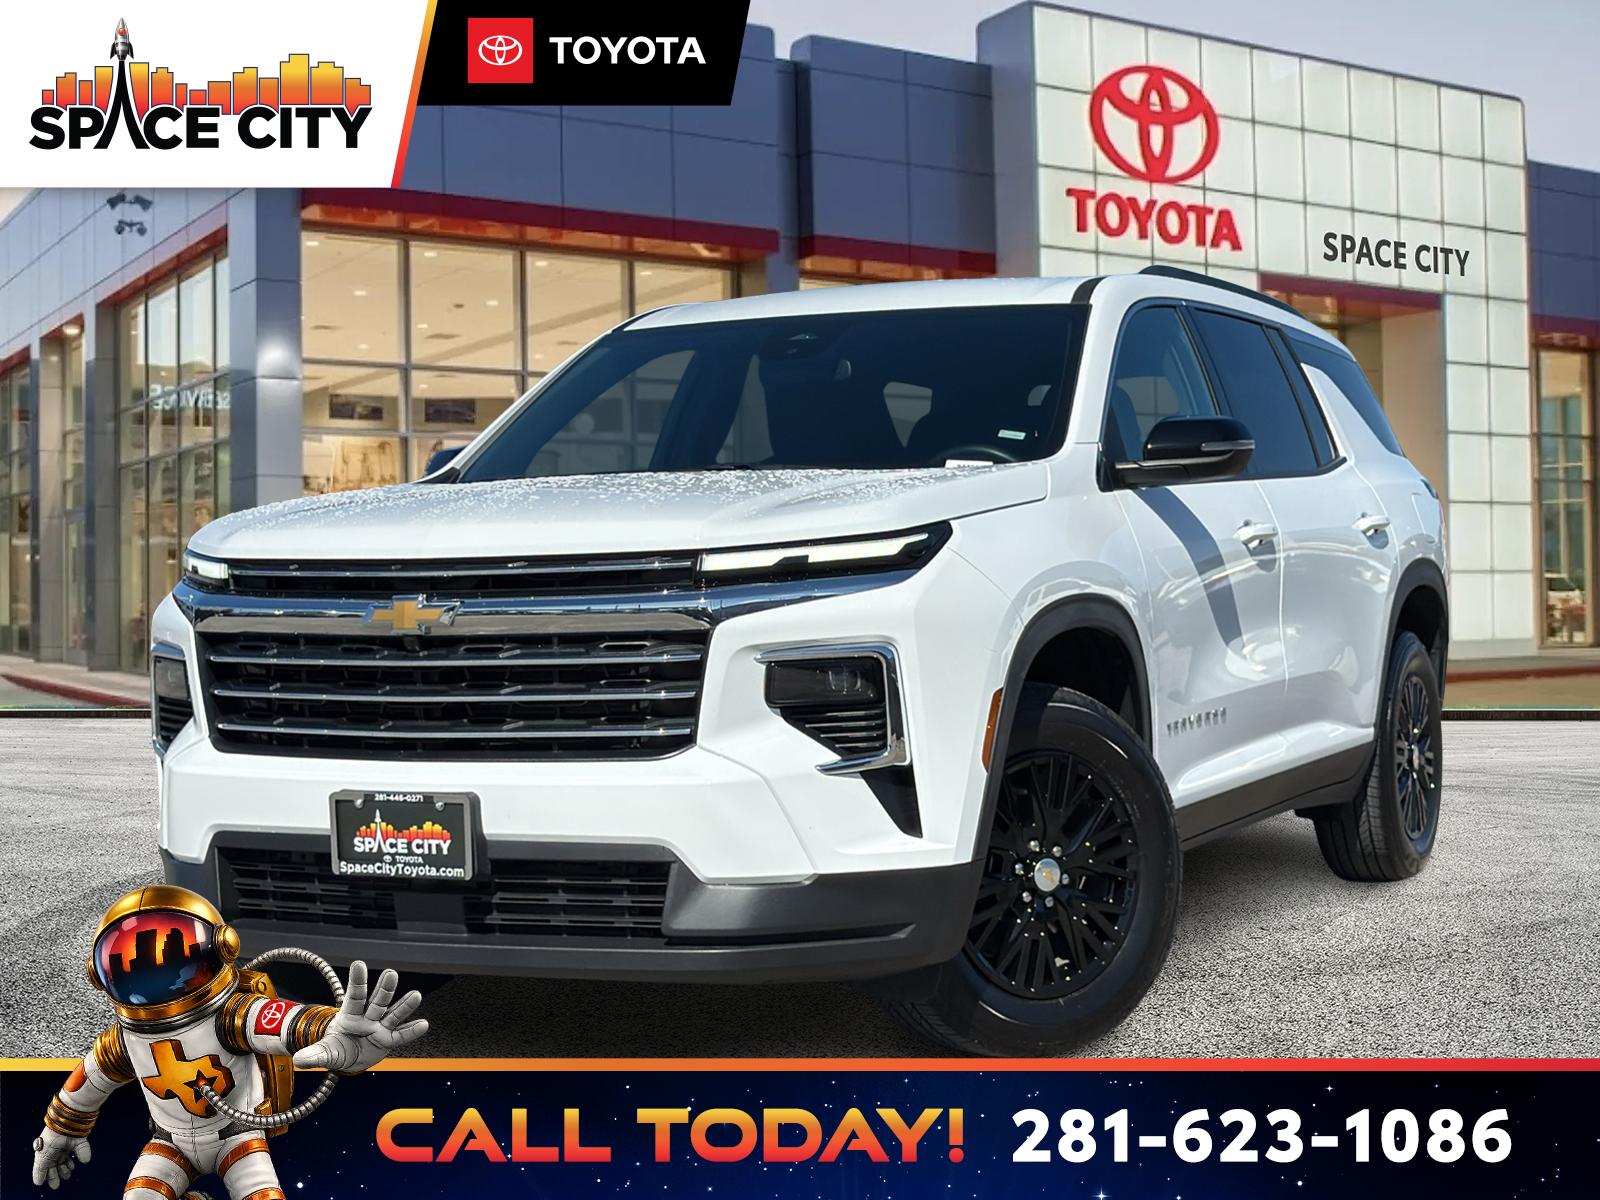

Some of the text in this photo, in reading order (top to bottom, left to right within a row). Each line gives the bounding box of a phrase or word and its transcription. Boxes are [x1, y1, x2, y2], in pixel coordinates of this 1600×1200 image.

[1067, 188, 1242, 250] TOYOTA
[1323, 232, 1469, 276] SPACE CITY
[353, 836, 451, 854] SPACE CITY
[395, 855, 423, 863] TOYOTA
[339, 861, 464, 877] SpaceCityToyota.com
